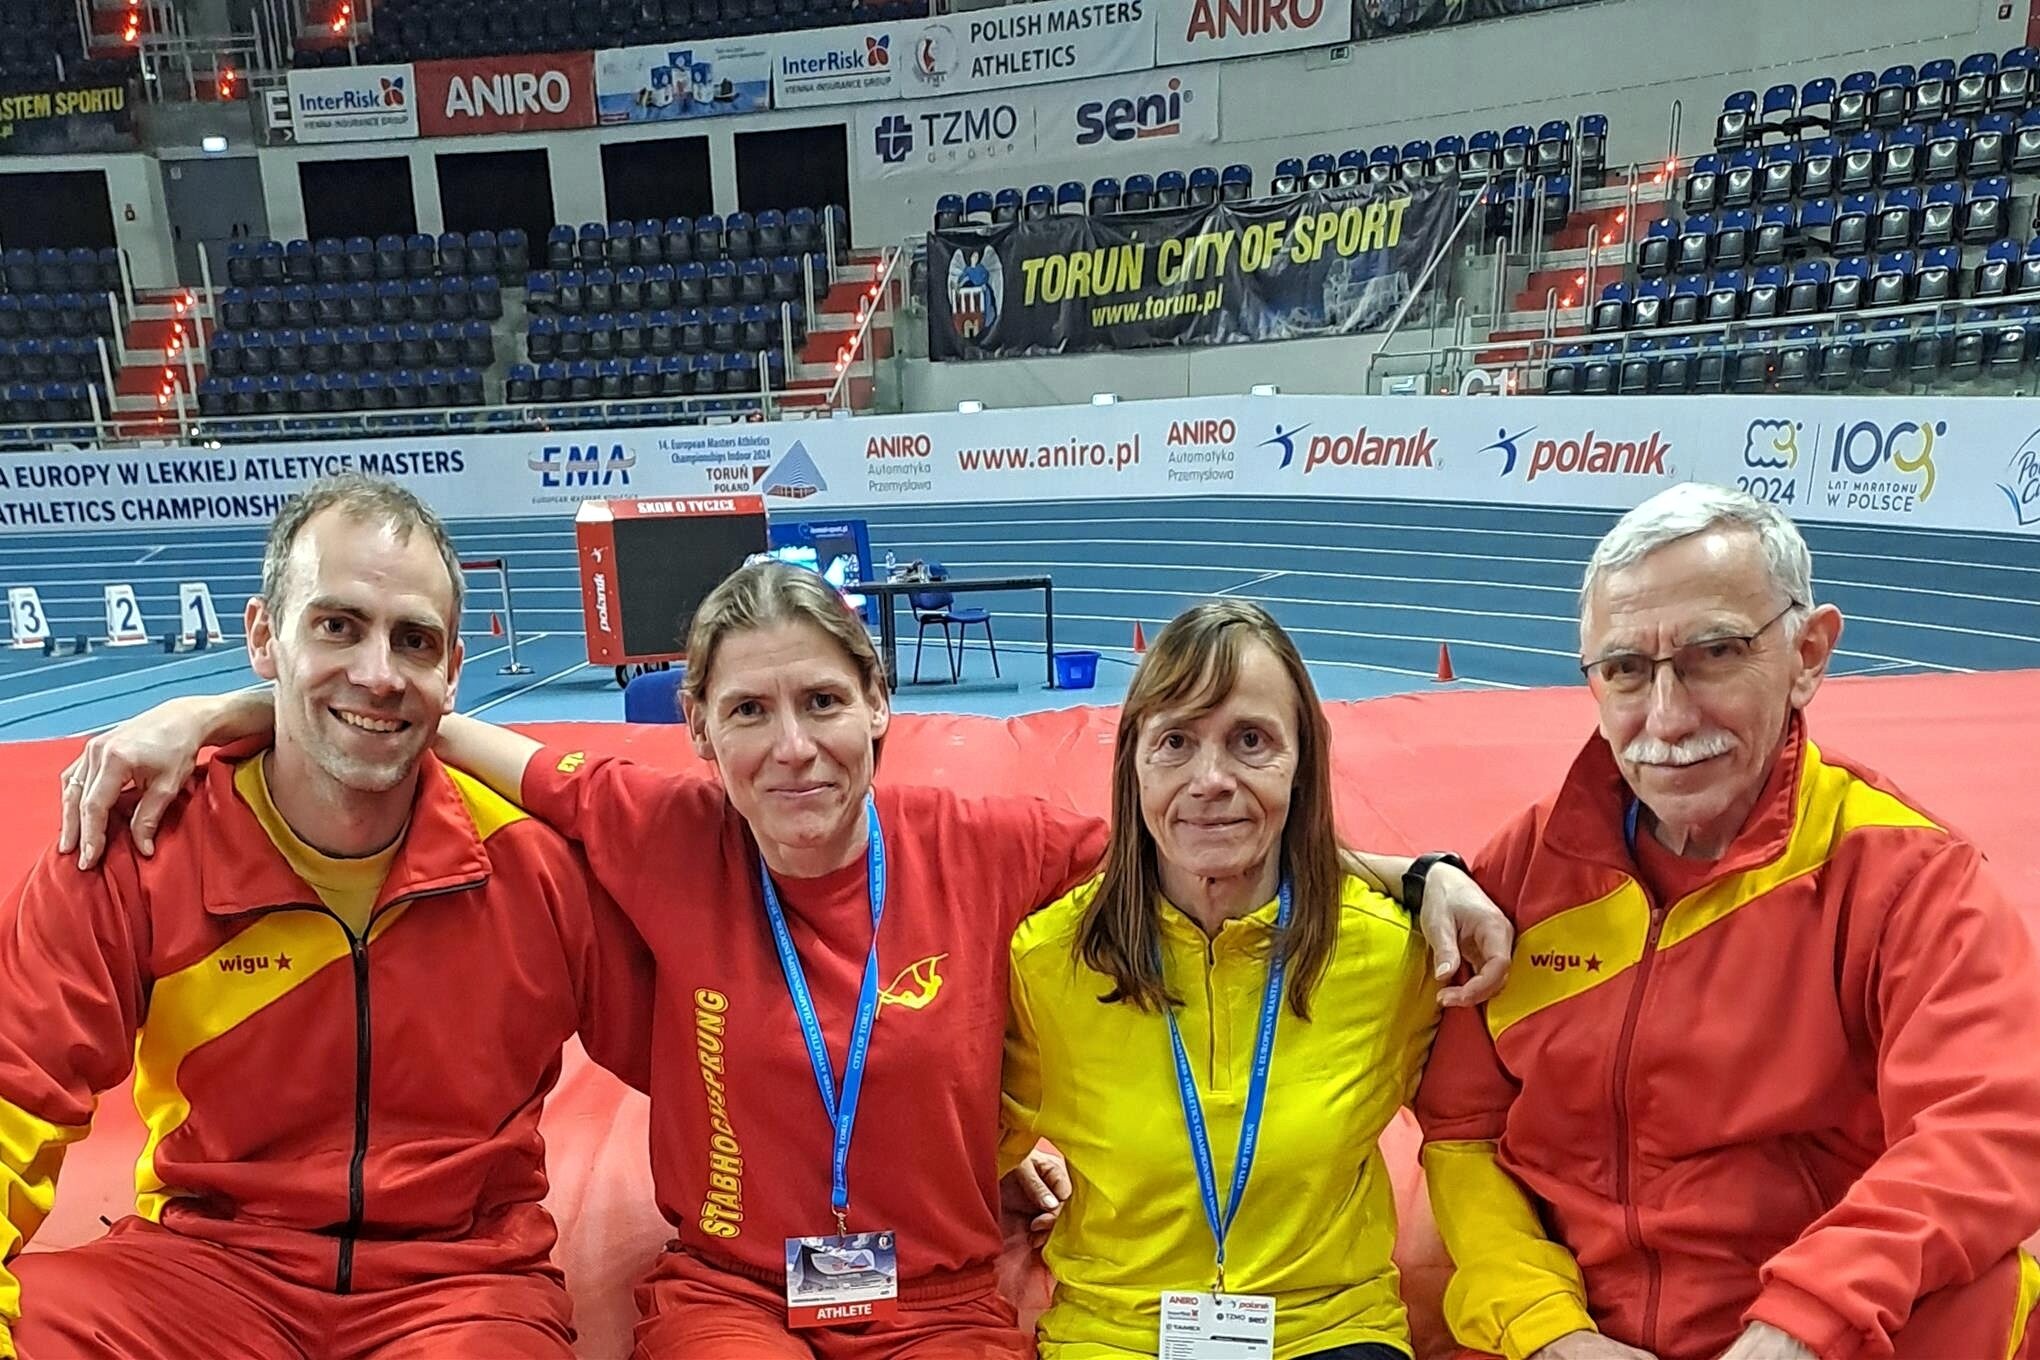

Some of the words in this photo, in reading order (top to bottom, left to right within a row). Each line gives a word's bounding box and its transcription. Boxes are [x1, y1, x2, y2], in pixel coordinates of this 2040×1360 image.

[971, 14, 1042, 44] POLISH
[1048, 1, 1143, 34] MASTERS
[1186, 0, 1324, 43] ANIRO
[782, 49, 865, 75] InterRisk
[971, 45, 1076, 78] ATHLETICS
[446, 70, 571, 118] ANIRO
[864, 76, 892, 88] GROUP
[55, 87, 125, 116] SPORTU
[300, 92, 381, 111] InterRisk
[1076, 77, 1181, 145] seni
[920, 105, 1017, 147] TZMO
[1022, 229, 1146, 307] TORUŃ
[1157, 229, 1234, 288] CITY
[1240, 219, 1293, 274] OF
[1292, 196, 1412, 266] SPORT
[1091, 285, 1224, 329] www.torun.pl
[866, 434, 931, 459] ANIRO
[1167, 418, 1236, 446] ANIRO
[958, 433, 1140, 472] www.aniro.pl
[1168, 448, 1234, 464] Automatyka
[1304, 425, 1440, 475] polanik
[1527, 430, 1672, 482] polanik
[15, 464, 111, 488] EUROPY
[118, 463, 139, 485] W
[147, 459, 236, 485] LEKKIEJ
[361, 450, 465, 476] MASTERS
[542, 444, 630, 487] EMA
[706, 464, 748, 481] TORUŃ
[714, 482, 750, 493] POLAND
[1828, 480, 1849, 490] LAT
[1854, 481, 1918, 494] MARATONU
[1827, 493, 1841, 507] W
[1847, 494, 1915, 512] POLSCE
[20, 601, 40, 633] 3
[116, 598, 138, 631] 2
[189, 595, 207, 637] 1
[219, 954, 269, 974] wigu
[1530, 950, 1580, 972] wigu
[857, 1035, 866, 1049] OF
[852, 1050, 864, 1070] CITY
[694, 988, 743, 1238] STABHOCHSPRUNG
[817, 1304, 873, 1320] ATHLETE
